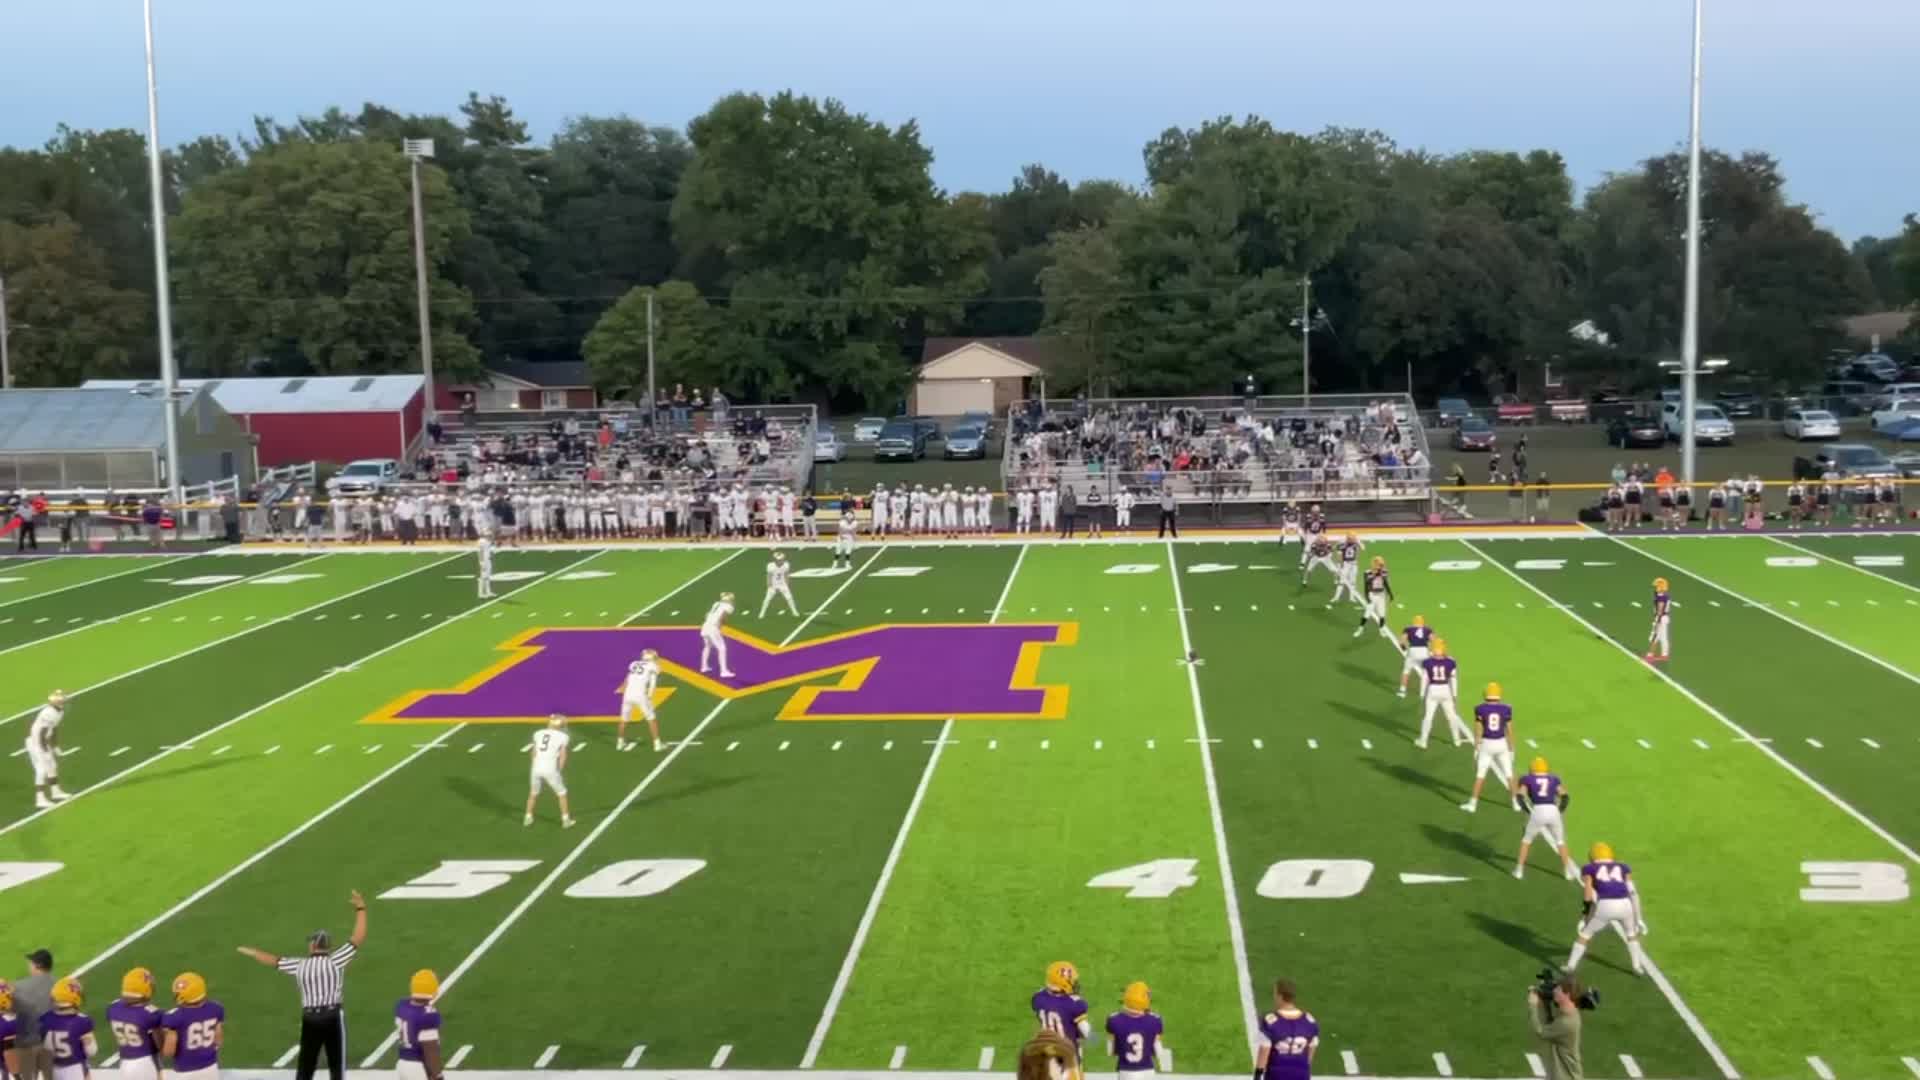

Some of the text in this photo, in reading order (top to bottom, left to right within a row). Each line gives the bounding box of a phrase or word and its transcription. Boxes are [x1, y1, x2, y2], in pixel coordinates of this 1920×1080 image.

[362, 622, 1078, 724] M
[1431, 665, 1446, 681] 11
[540, 734, 551, 751] 9
[1535, 777, 1549, 797] 7
[1596, 865, 1624, 882] 44
[187, 1018, 218, 1050] 65
[1126, 1033, 1145, 1062] 3
